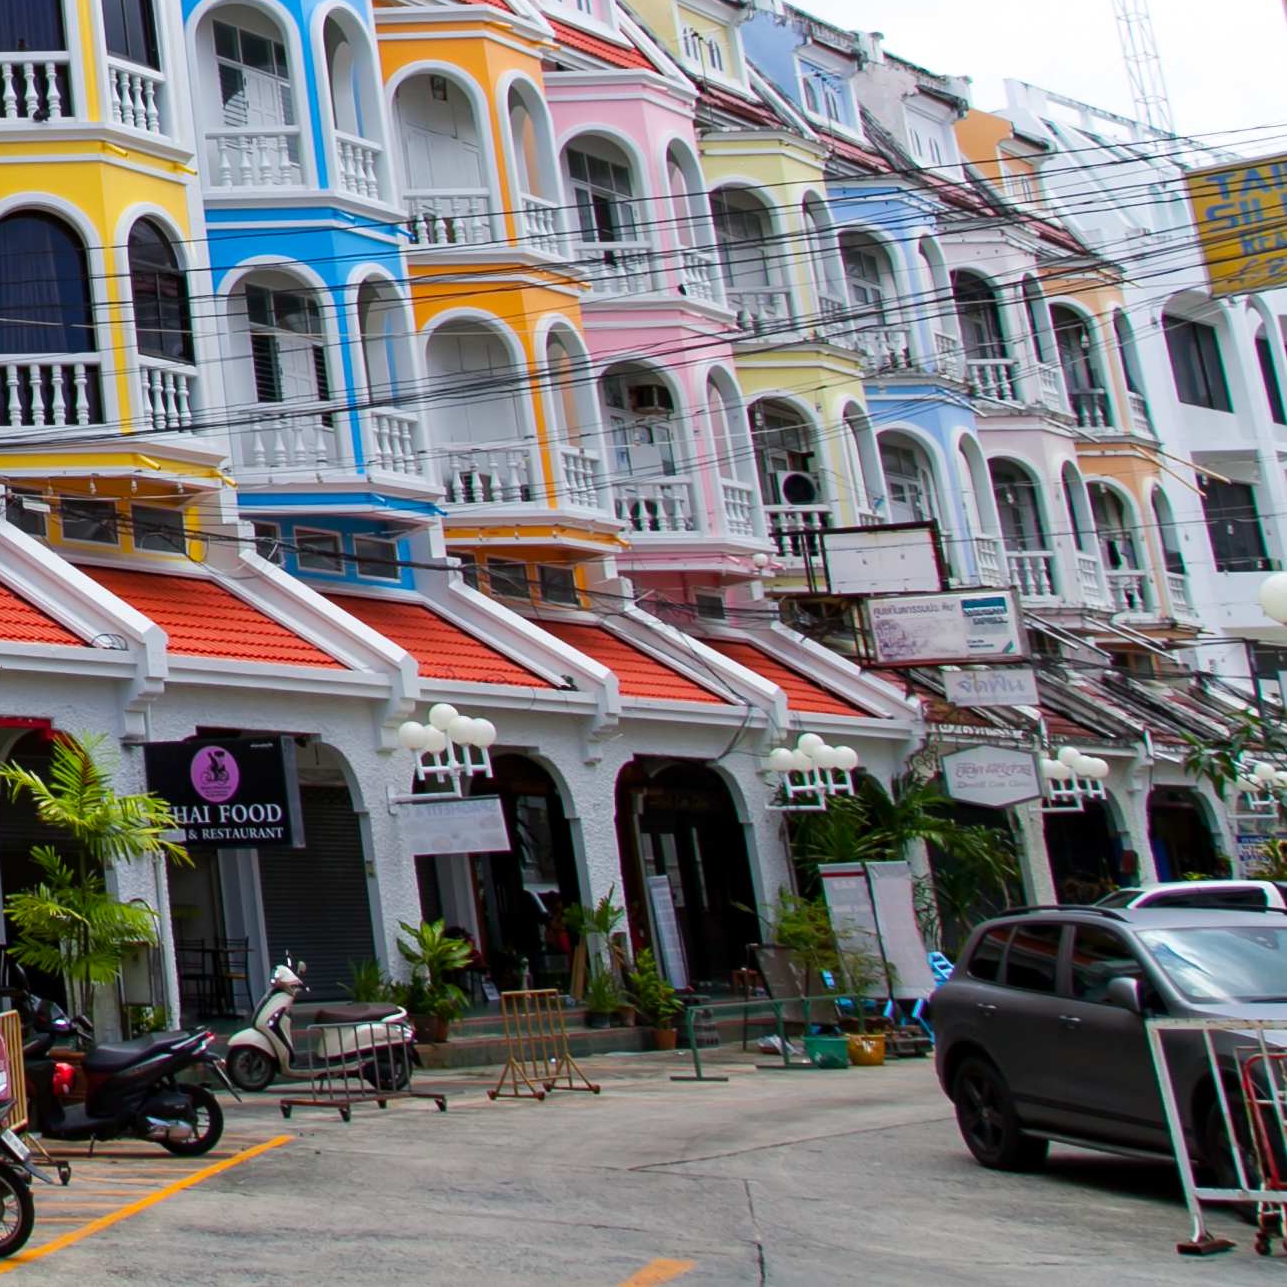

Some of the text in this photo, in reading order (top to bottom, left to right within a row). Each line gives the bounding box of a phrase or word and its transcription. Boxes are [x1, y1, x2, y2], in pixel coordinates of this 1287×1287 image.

[167, 803, 282, 824] HAI FOOD
[188, 827, 284, 839] & RESTAURANT
